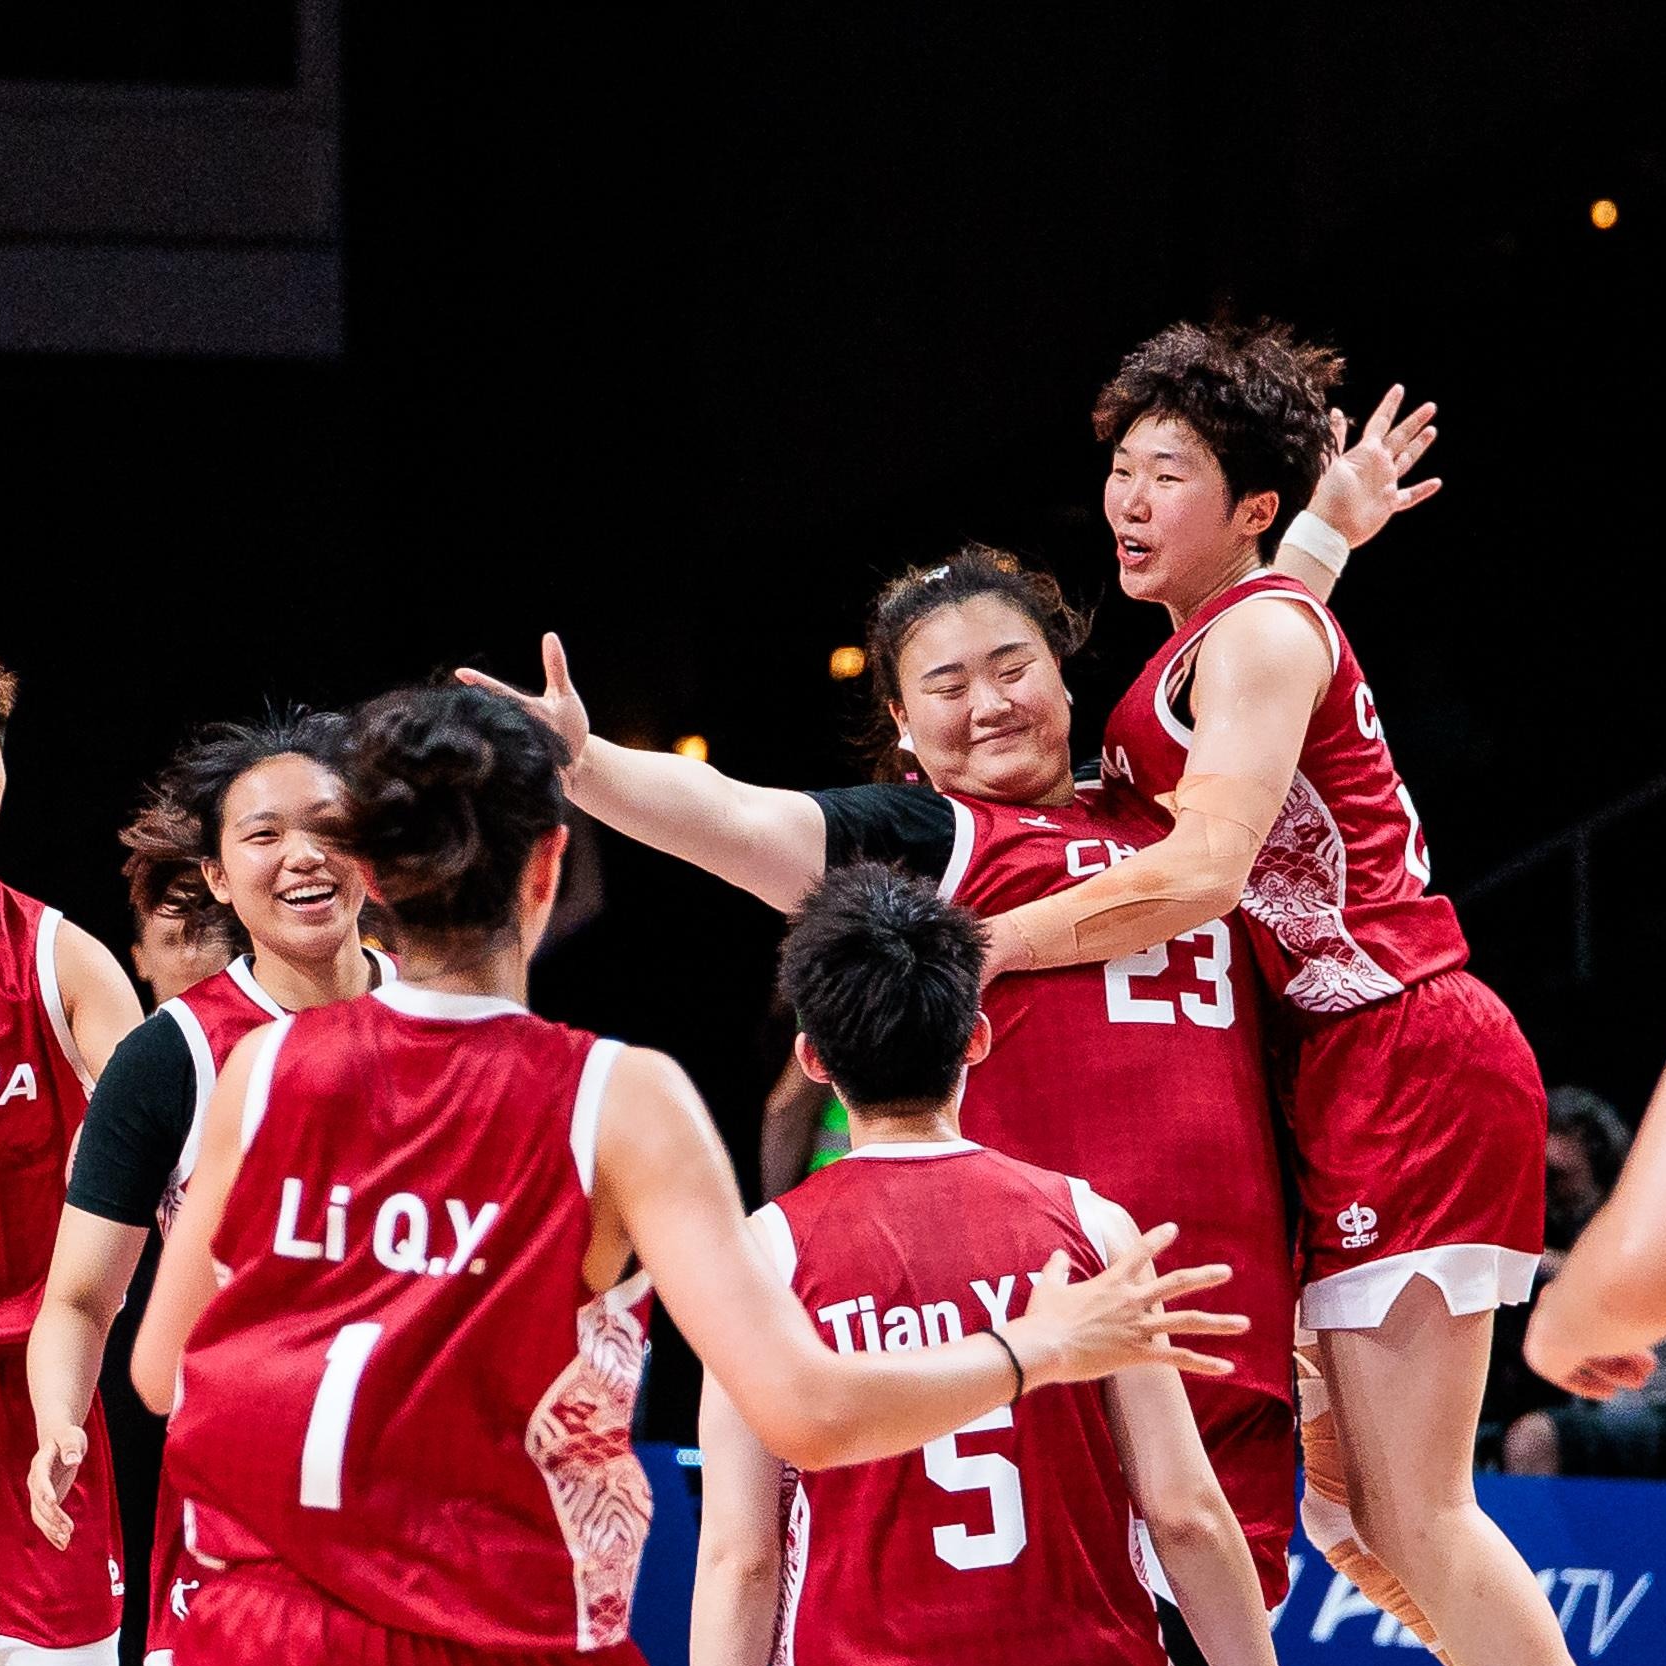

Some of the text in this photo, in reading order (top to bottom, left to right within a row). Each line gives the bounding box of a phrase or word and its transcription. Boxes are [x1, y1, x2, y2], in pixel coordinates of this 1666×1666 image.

[1104, 918, 1235, 1029] 23
[273, 1177, 501, 1278] Li Q.Y.
[817, 1294, 965, 1356] Tian
[300, 1321, 383, 1511] 1
[922, 1403, 1027, 1570] 5
